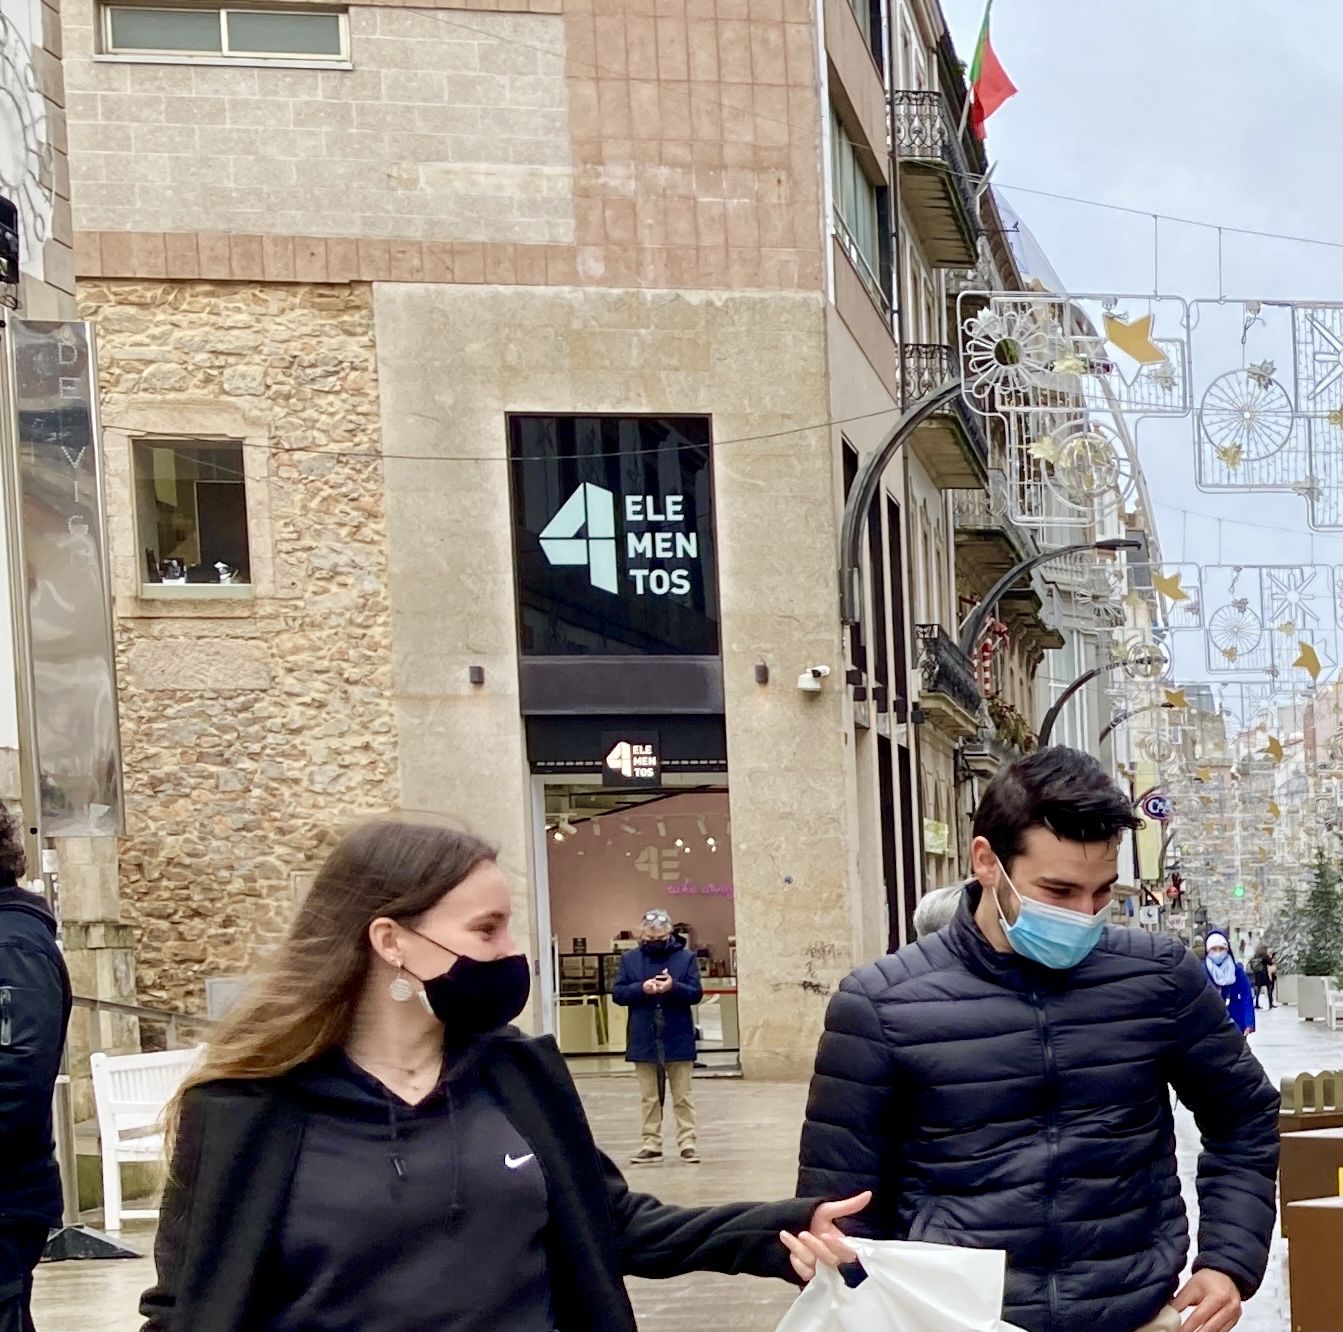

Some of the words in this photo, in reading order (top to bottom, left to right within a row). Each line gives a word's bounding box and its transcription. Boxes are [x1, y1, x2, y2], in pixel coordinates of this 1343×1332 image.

[625, 495, 685, 521] ELE
[539, 481, 619, 595] 4
[627, 532, 698, 558] MEN
[629, 569, 691, 595] TOS
[606, 741, 632, 777] 4
[632, 745, 653, 754] ELE
[633, 756, 657, 766] MEN
[633, 768, 655, 777] TOS
